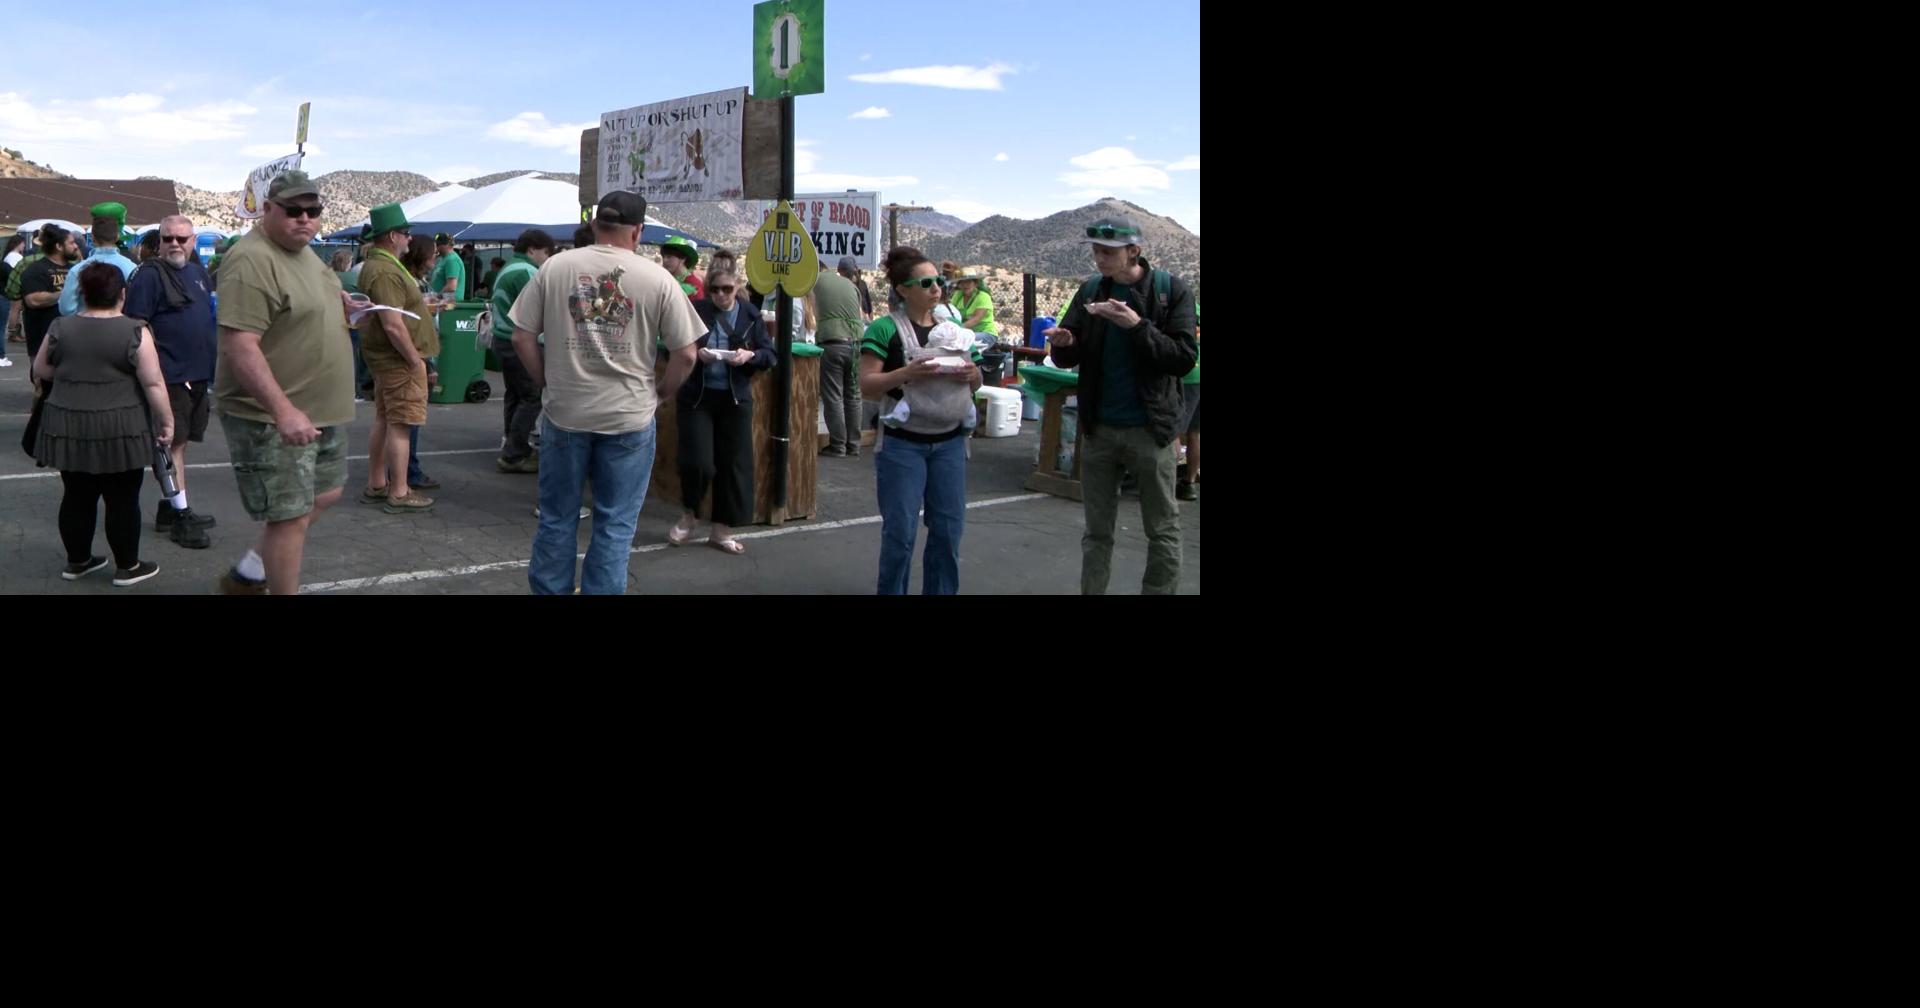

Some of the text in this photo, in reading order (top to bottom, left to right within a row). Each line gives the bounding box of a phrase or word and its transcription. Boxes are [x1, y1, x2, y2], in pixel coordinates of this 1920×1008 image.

[780, 19, 789, 69] 1
[631, 116, 646, 128] UP
[647, 111, 670, 127] OR
[670, 104, 711, 122] SHUT
[716, 100, 737, 116] UP
[811, 201, 824, 217] OF
[829, 201, 871, 231] BLOOD
[810, 232, 866, 256] KING
[772, 264, 790, 275] LINE
